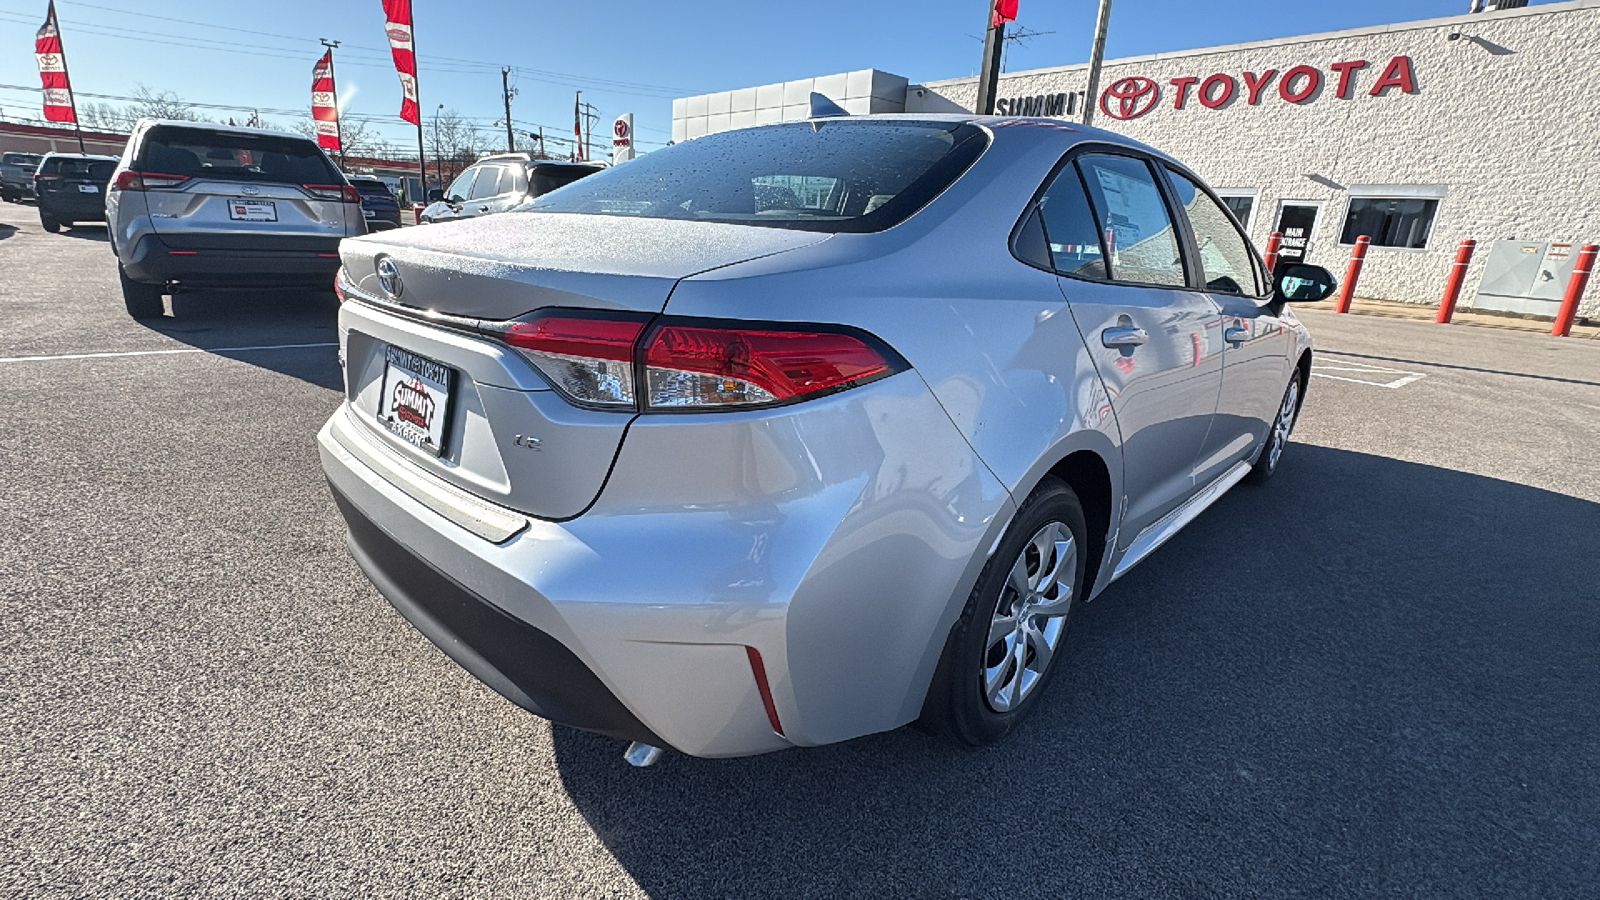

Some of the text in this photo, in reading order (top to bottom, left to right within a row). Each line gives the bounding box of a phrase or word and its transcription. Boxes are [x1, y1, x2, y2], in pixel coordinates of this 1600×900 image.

[1169, 55, 1414, 109] TOYOTA
[1285, 227, 1304, 237] MAIN
[421, 360, 448, 386] TOYOTA
[393, 383, 435, 427] SUMMIT
[513, 434, 543, 451] LE
